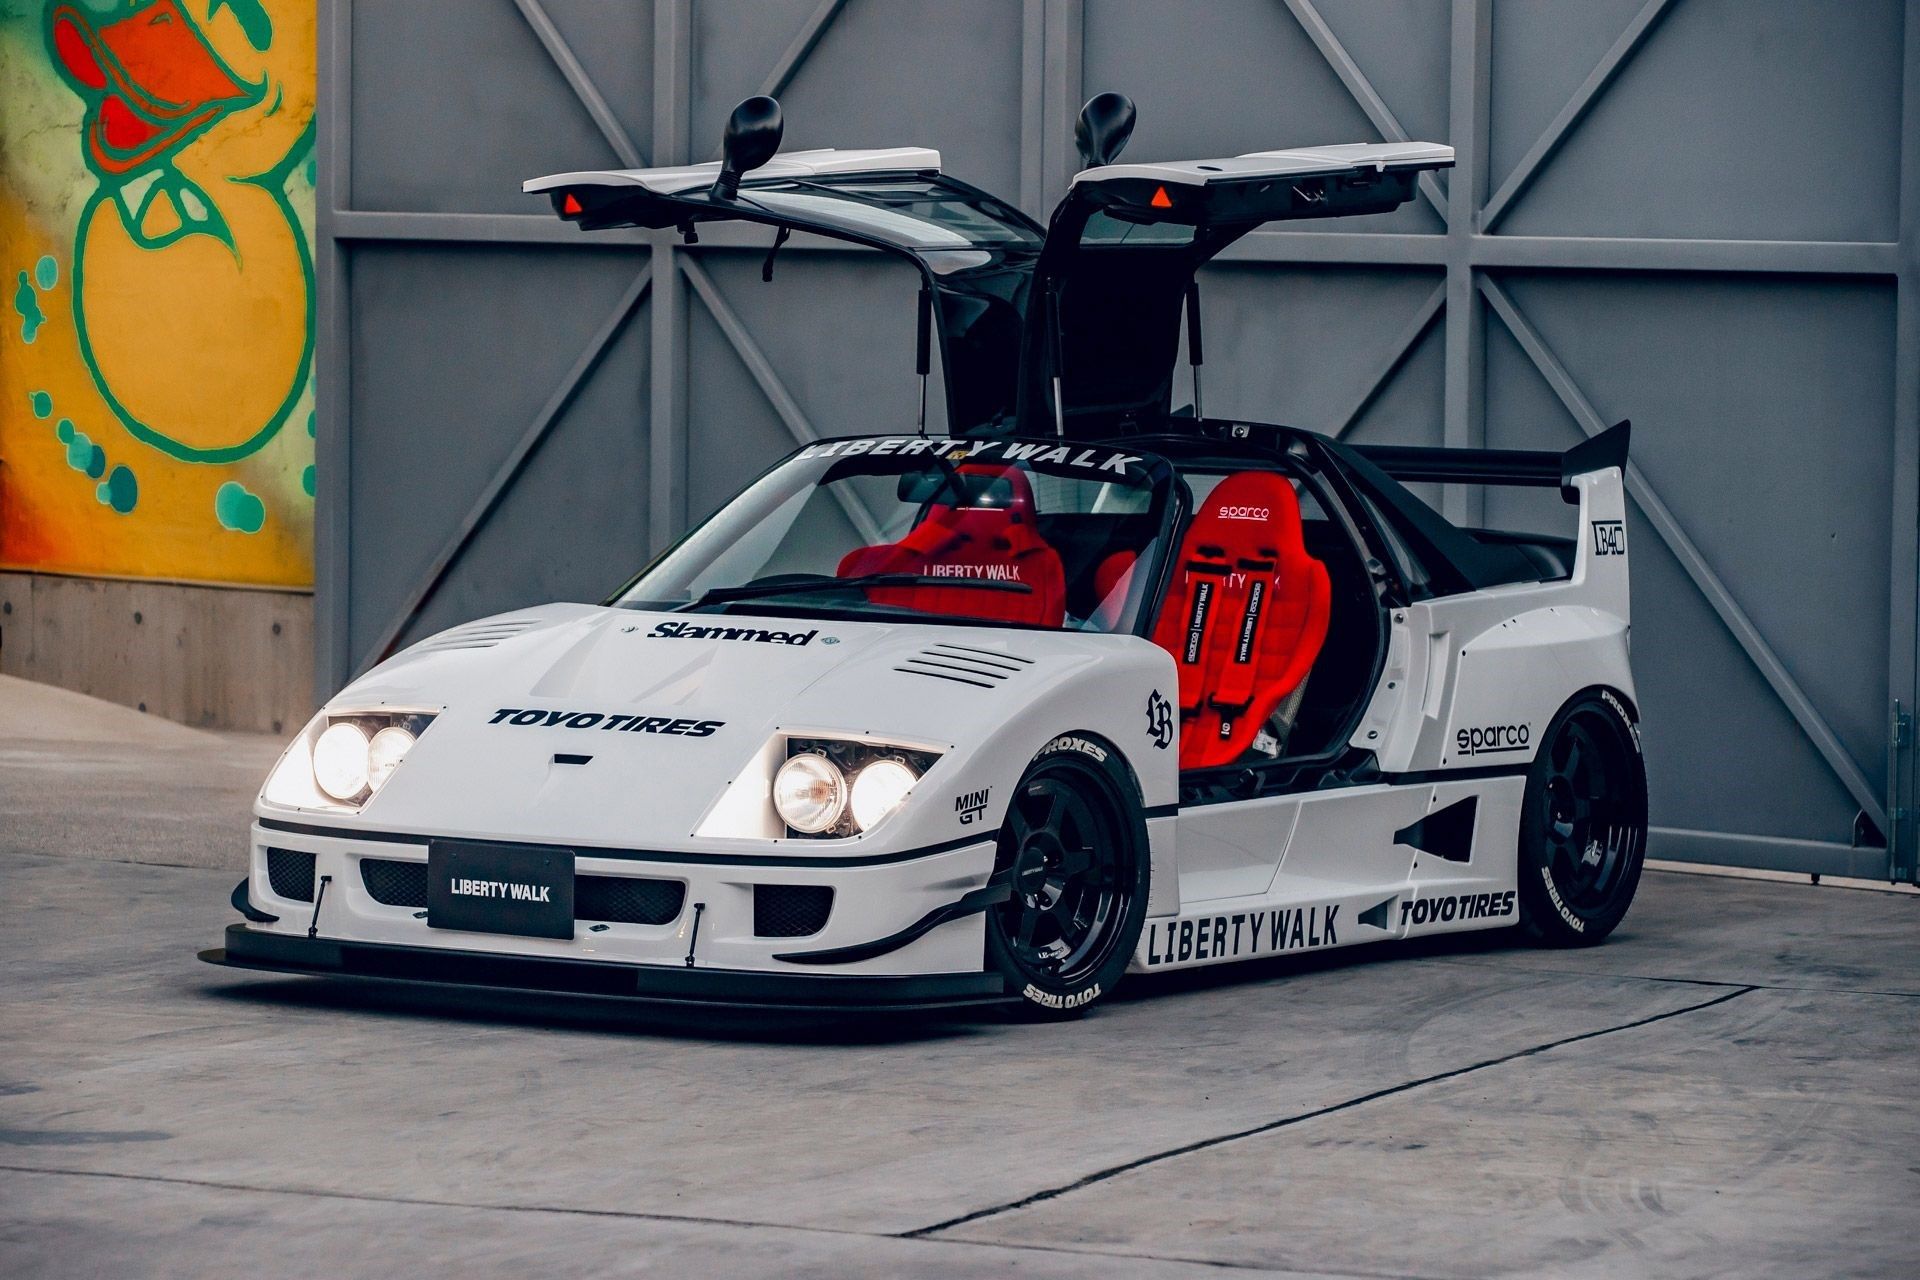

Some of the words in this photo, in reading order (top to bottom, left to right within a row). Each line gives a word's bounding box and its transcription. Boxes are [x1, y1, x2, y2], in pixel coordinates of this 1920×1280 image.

[794, 439, 1002, 461] LIBERTY
[1001, 442, 1145, 475] WALK
[1218, 506, 1270, 521] sparco
[985, 564, 1021, 581] WALK
[646, 621, 819, 646] Slammed
[1457, 724, 1530, 756] sparco
[955, 788, 990, 812] MINI
[960, 804, 988, 825] GT
[451, 878, 508, 898] LIBERTY
[510, 883, 550, 902] WALK
[1148, 911, 1266, 966] LIBERTY
[1270, 904, 1340, 951] WALK
[1022, 983, 1064, 1009] TIRES
[1064, 982, 1102, 1009] TOYO
